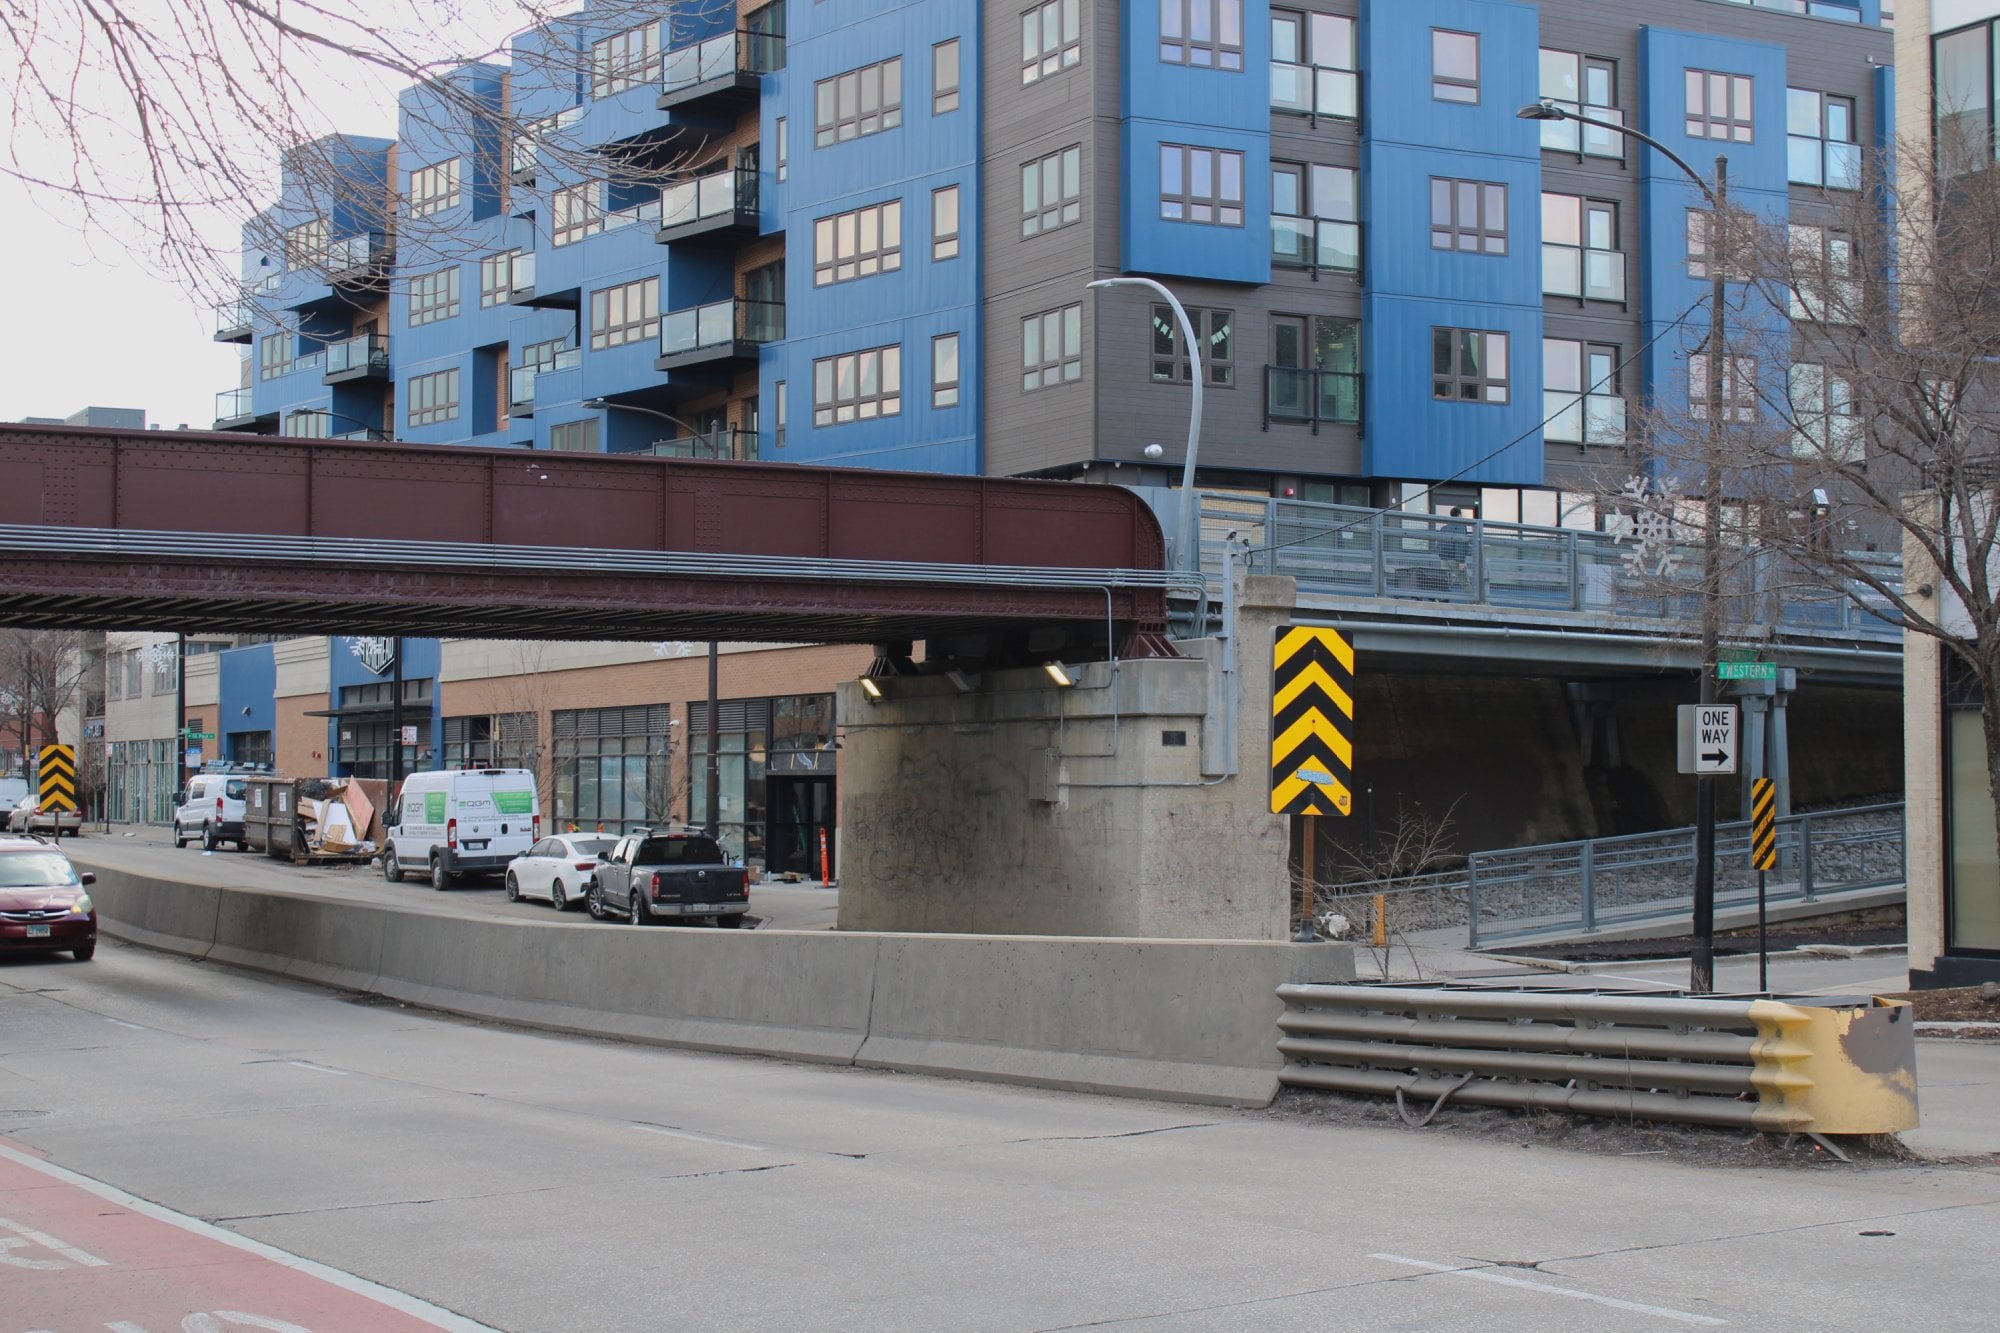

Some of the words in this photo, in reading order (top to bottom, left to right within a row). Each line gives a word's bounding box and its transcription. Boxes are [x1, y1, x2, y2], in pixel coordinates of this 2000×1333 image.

[1726, 664, 1768, 678] WESTERN
[1702, 711, 1729, 726] ONE
[1702, 729, 1729, 744] WAY
